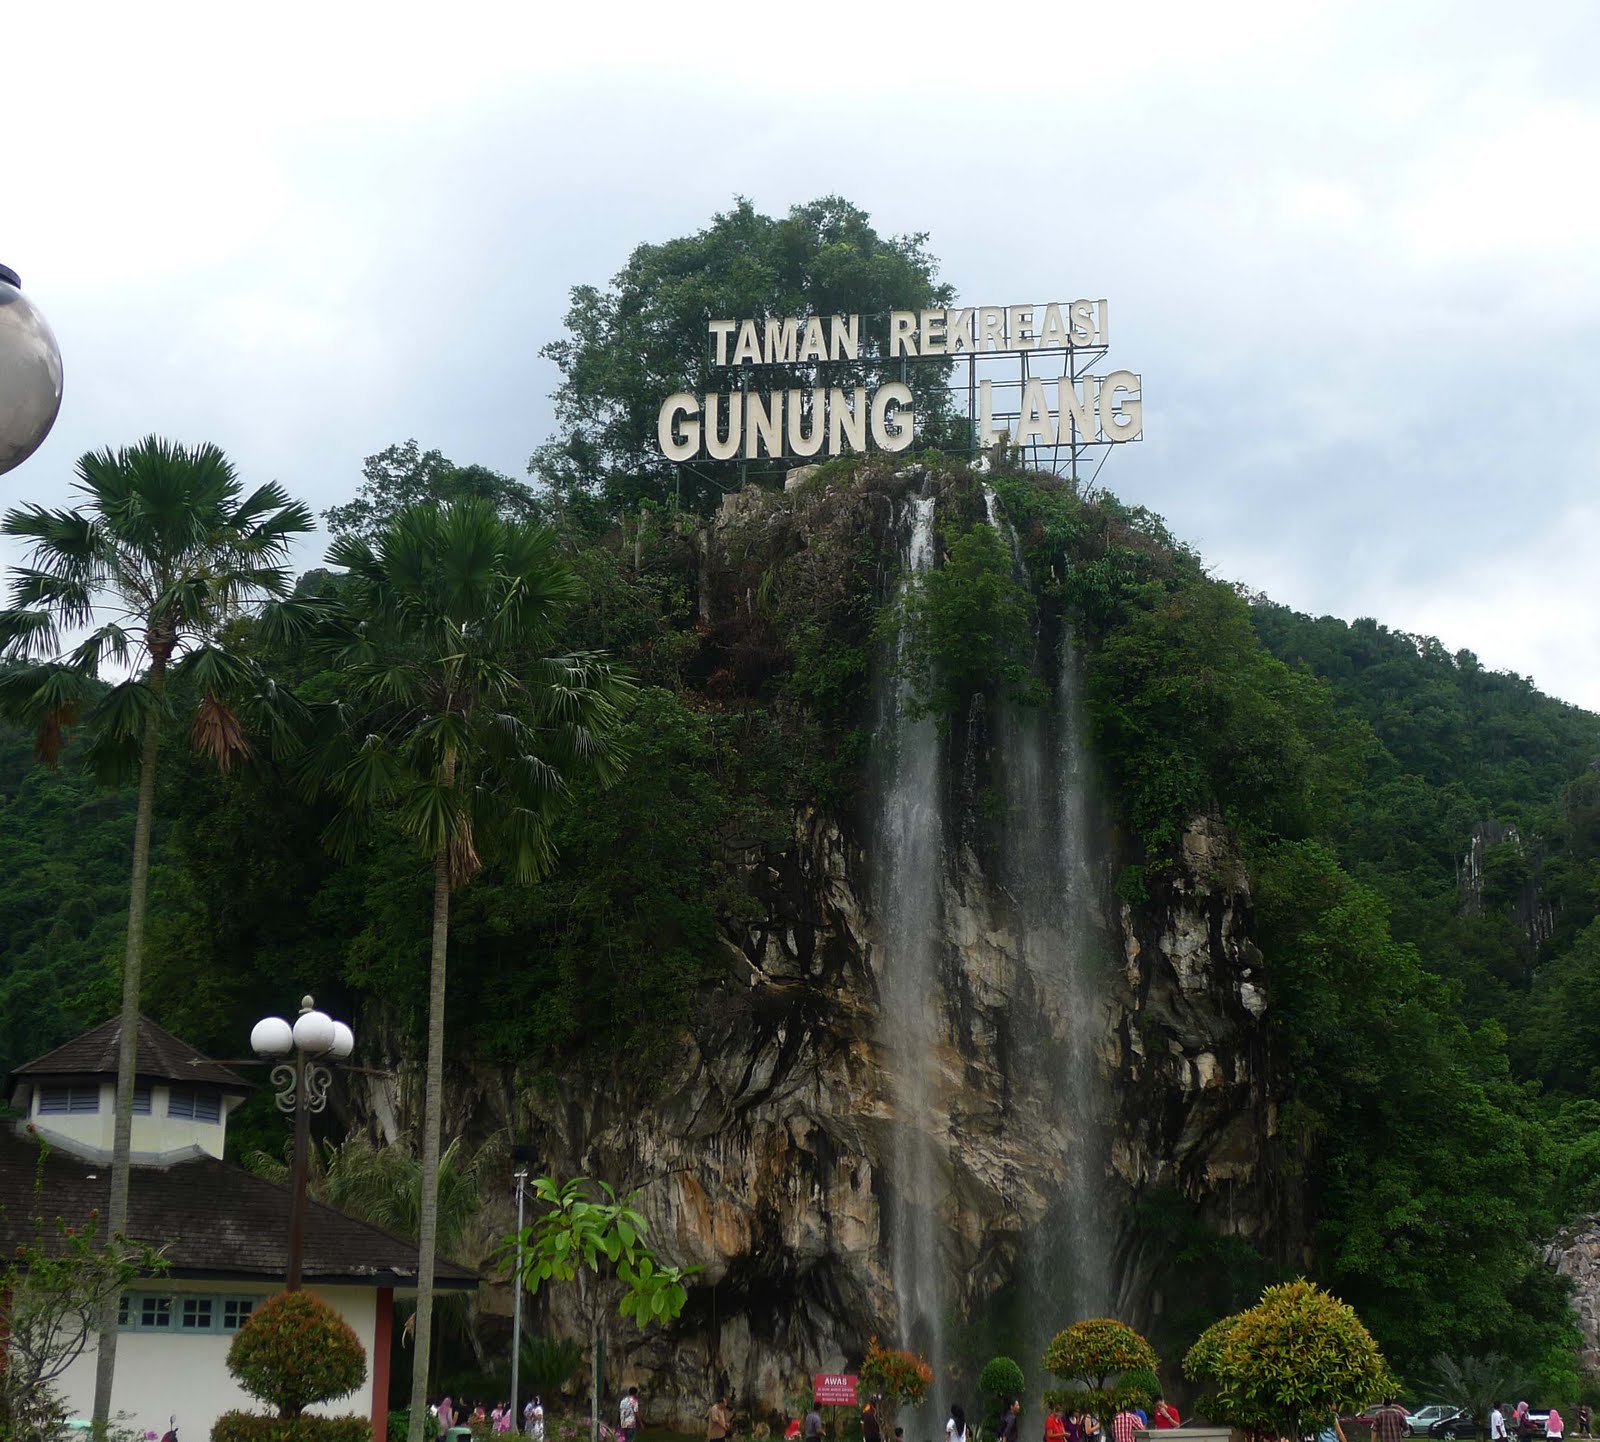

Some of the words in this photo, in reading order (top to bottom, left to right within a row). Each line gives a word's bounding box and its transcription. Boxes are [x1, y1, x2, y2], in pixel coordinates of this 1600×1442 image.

[708, 314, 859, 366] TAMAN
[890, 299, 1109, 357] REKREASI
[658, 382, 914, 462] GUNUNG
[979, 370, 1143, 448] LANG
[824, 1377, 847, 1385] AWAS
